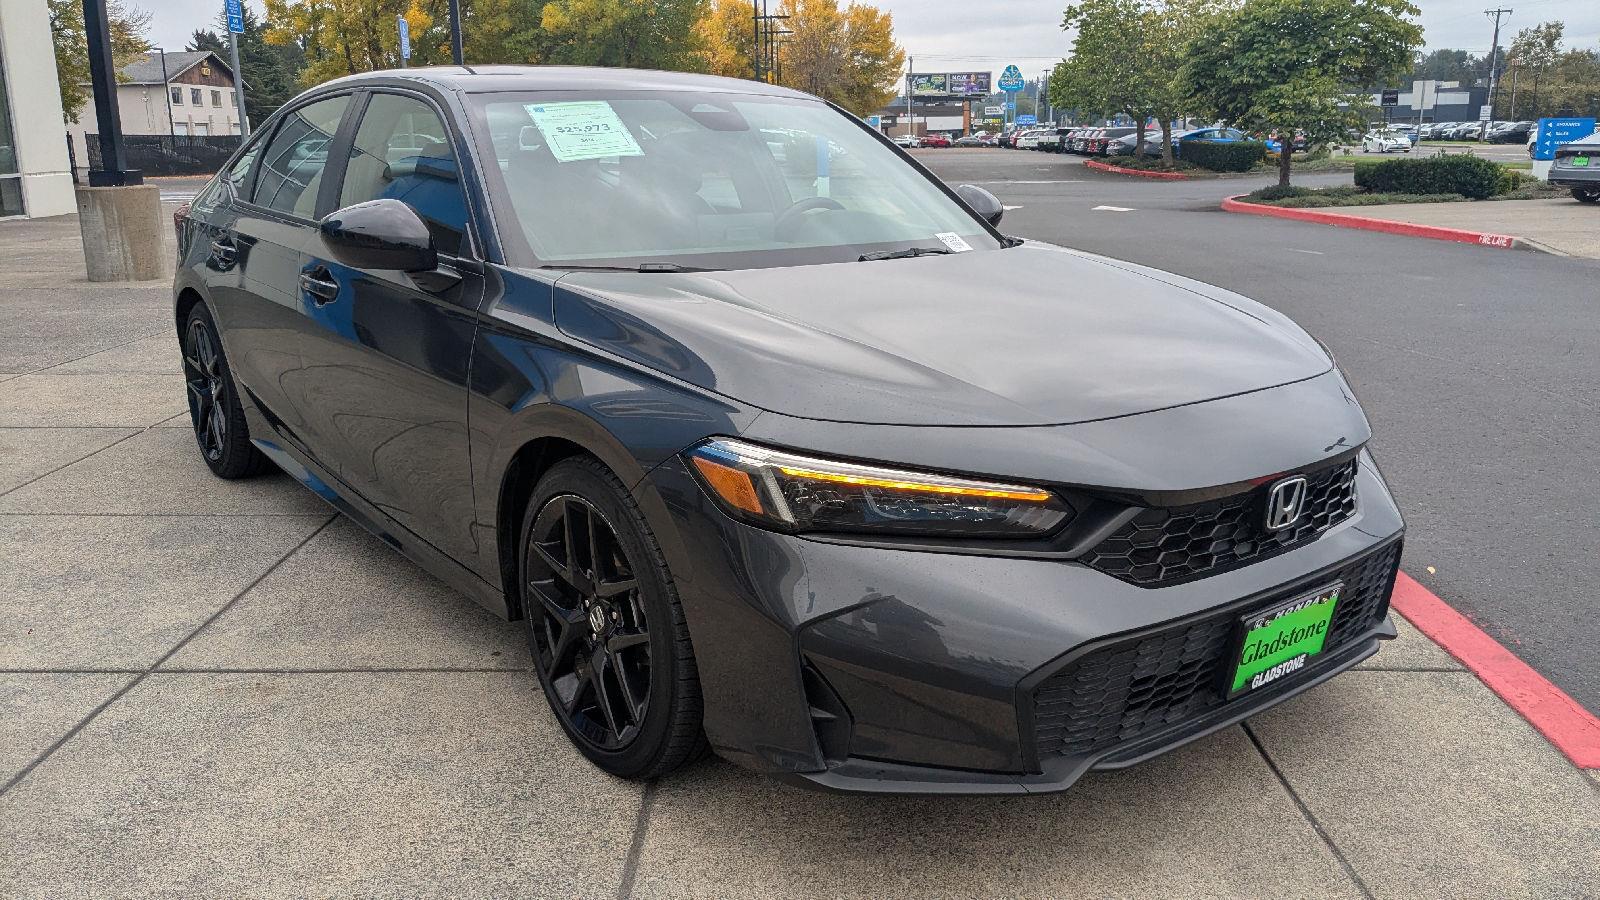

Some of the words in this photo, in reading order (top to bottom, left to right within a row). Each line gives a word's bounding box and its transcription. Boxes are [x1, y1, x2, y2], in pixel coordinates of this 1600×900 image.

[1275, 596, 1320, 619] HONDA
[1240, 619, 1327, 666] Gladstone
[1252, 653, 1307, 689] GLADSTONE
